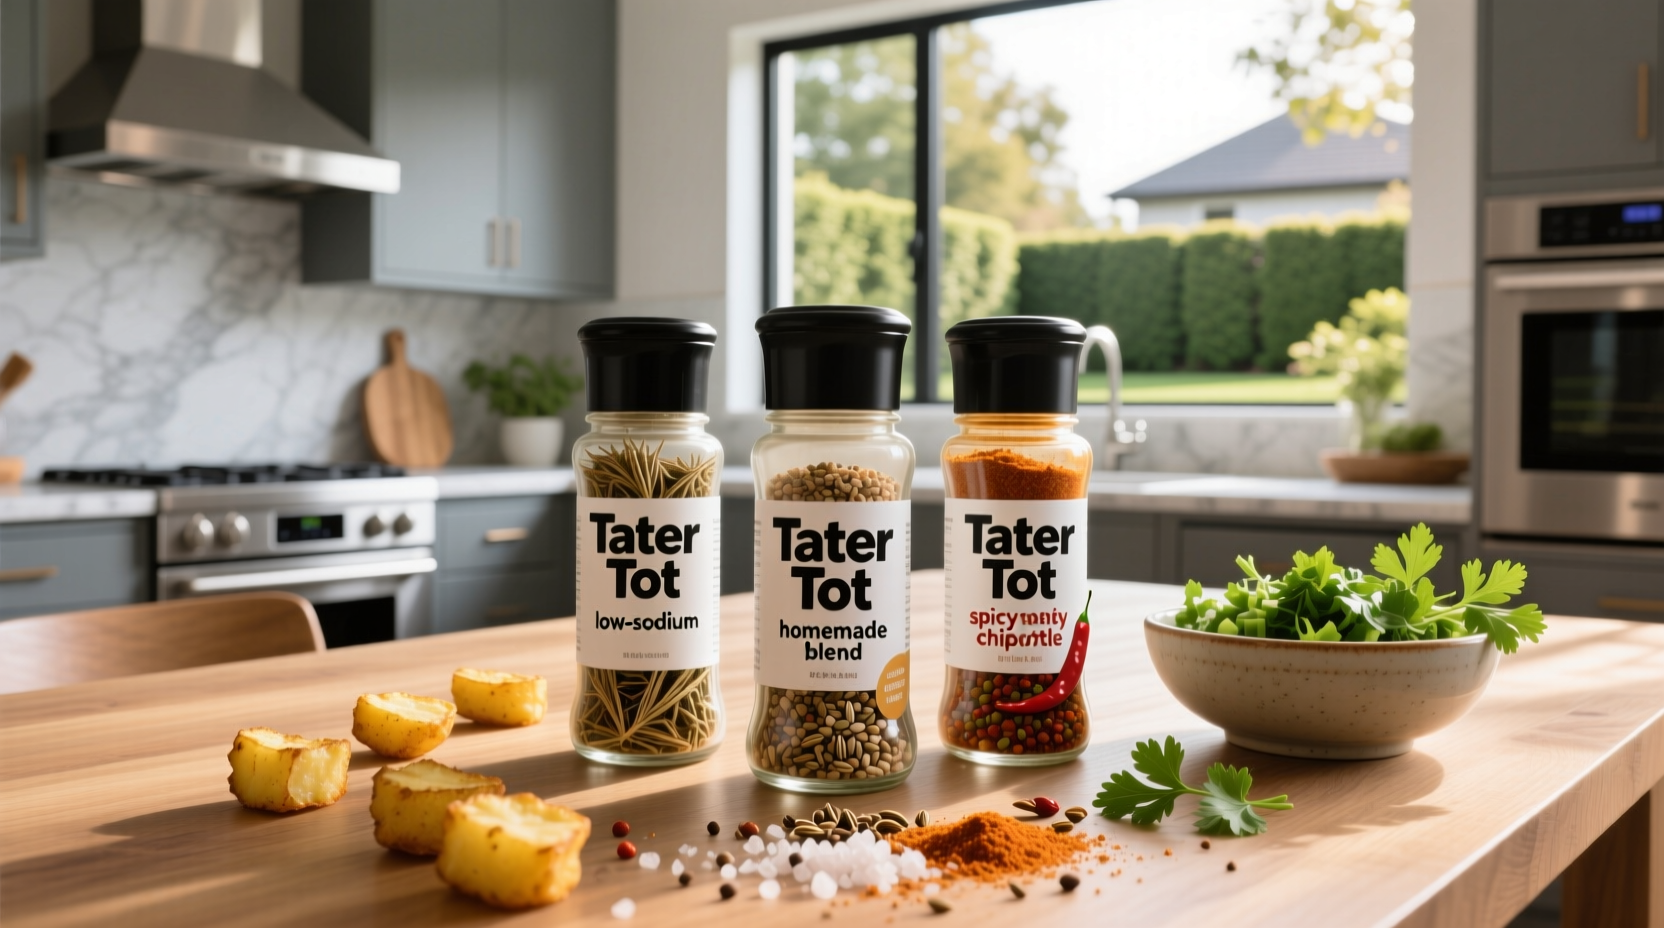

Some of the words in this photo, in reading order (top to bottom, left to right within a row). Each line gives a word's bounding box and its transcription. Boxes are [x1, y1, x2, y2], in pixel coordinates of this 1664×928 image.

[590, 513, 700, 555] Tater
[773, 517, 893, 563] Tater
[965, 514, 1074, 556] Tater
[606, 558, 680, 599] Tot
[791, 566, 871, 611] Tot
[983, 559, 1056, 600] Tot
[596, 611, 698, 630] low-sodium
[780, 619, 887, 639] homemade
[805, 641, 861, 661] blend
